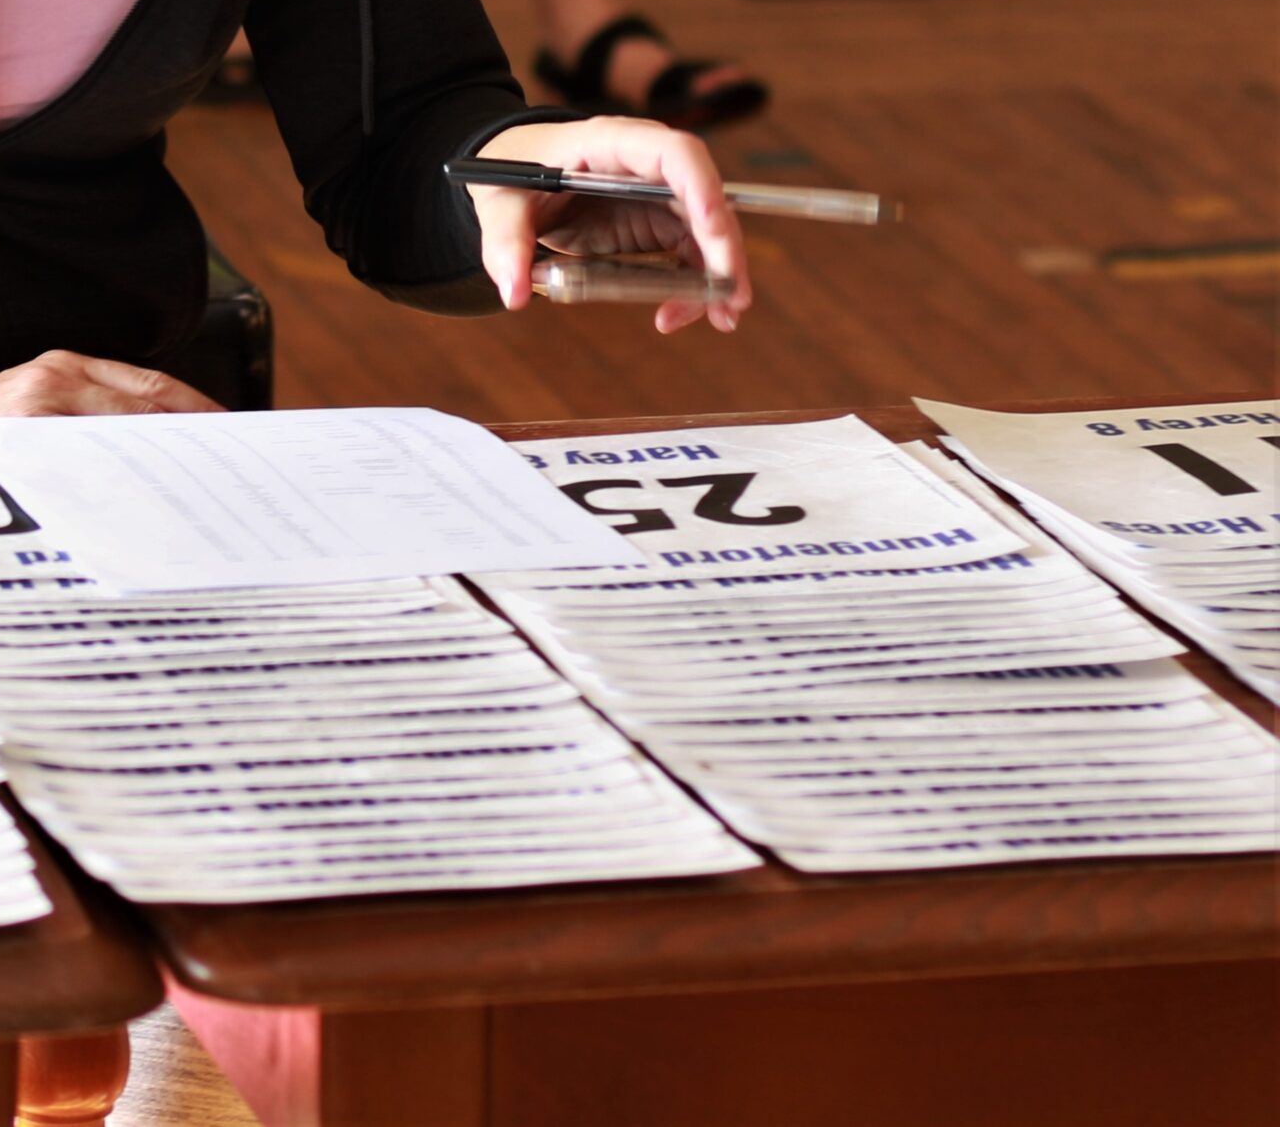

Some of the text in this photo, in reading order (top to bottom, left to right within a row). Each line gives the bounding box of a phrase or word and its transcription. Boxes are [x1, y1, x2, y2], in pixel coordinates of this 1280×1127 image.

[1086, 412, 1280, 437] Harey 8
[564, 444, 723, 466] Harey
[558, 472, 807, 535] 25
[1098, 516, 1267, 535] Hares
[658, 527, 979, 568] Hungerford
